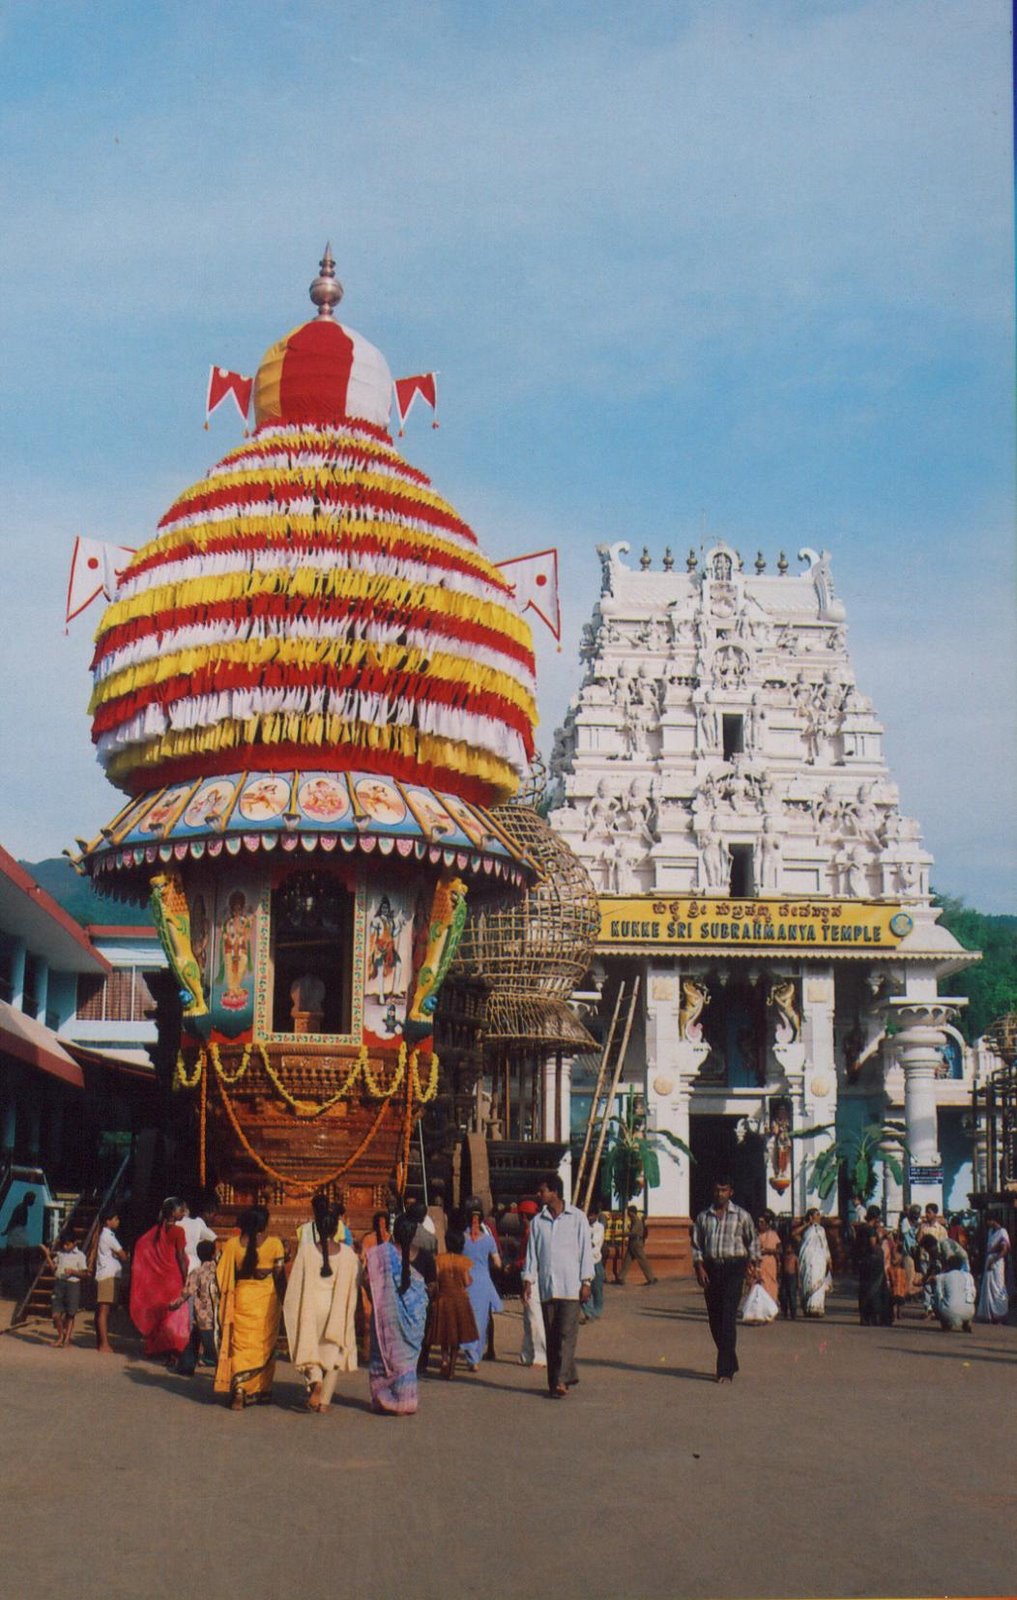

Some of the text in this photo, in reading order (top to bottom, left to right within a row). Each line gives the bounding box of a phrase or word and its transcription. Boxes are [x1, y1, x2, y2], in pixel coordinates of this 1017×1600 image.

[610, 920, 882, 942] KUKKE SRI SUBRAHMANYA TEMPLE
